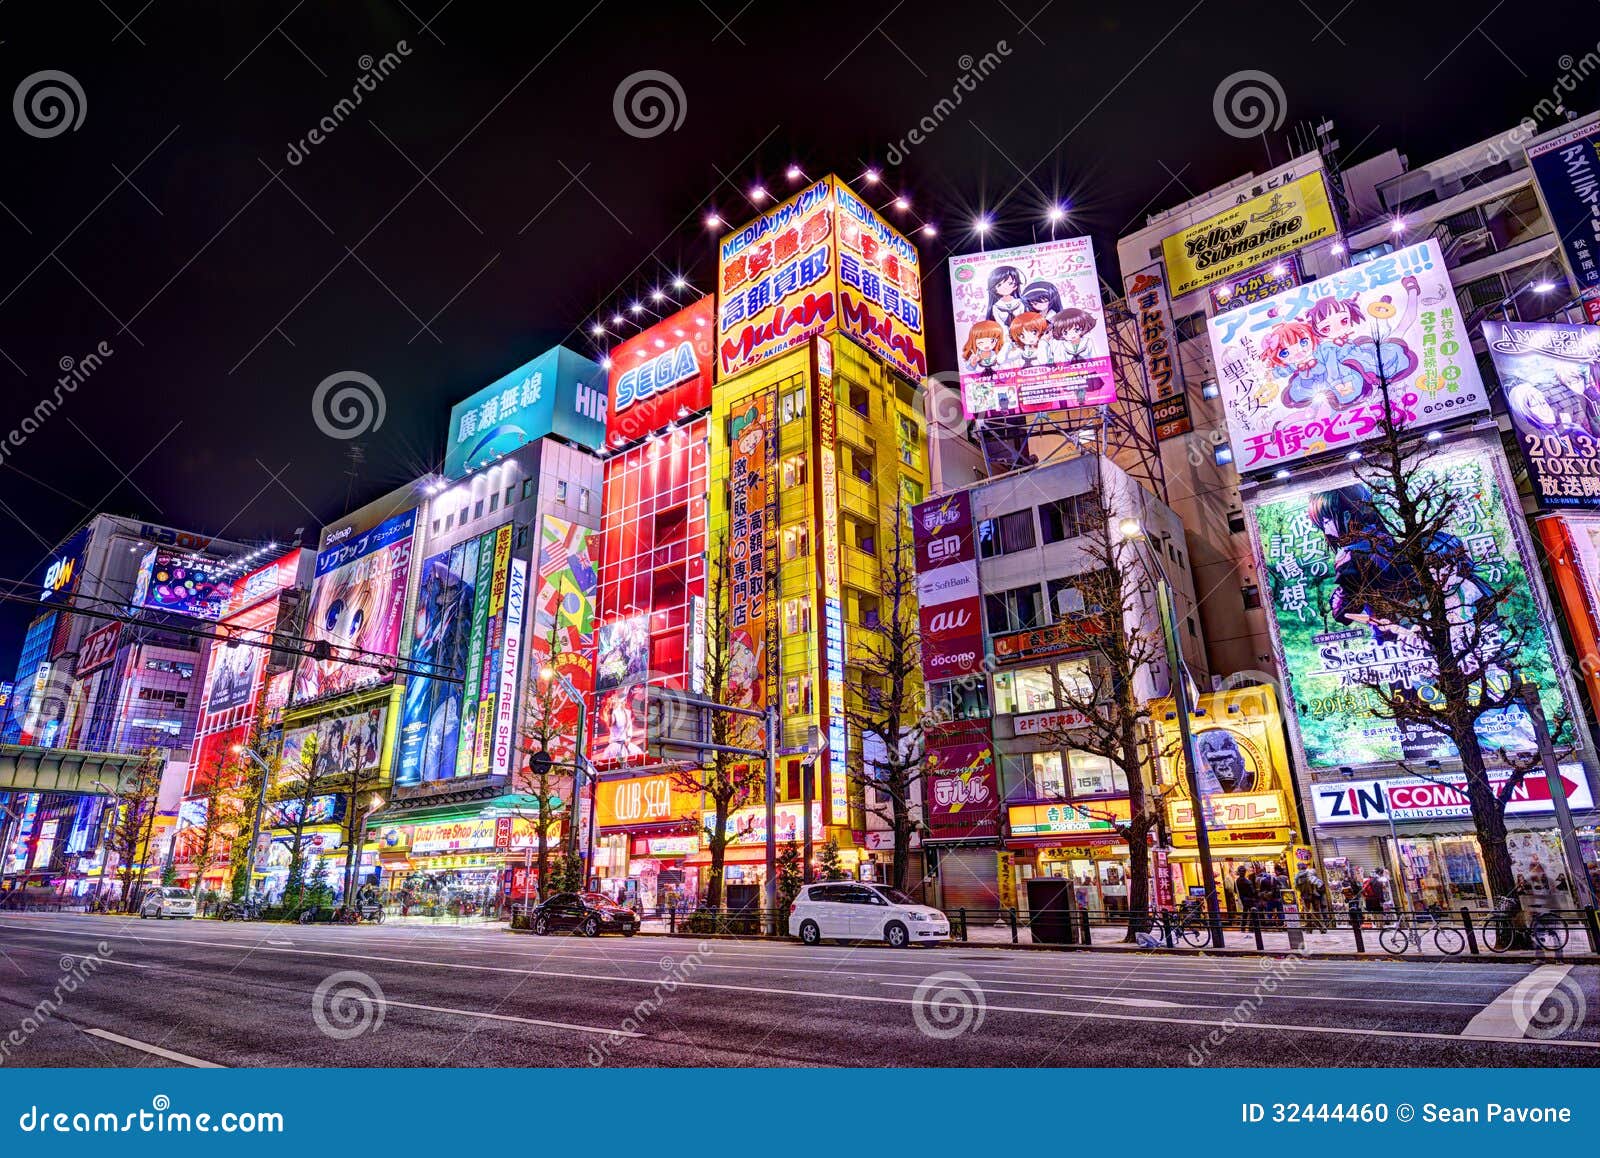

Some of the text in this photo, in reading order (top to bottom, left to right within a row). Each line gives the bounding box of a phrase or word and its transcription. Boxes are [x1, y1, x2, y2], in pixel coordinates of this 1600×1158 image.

[1186, 211, 1240, 239] HOBBY BASE
[1186, 221, 1248, 256] Yellow
[1196, 216, 1302, 270] Submarine
[722, 208, 831, 292] 激安販売
[1573, 239, 1600, 281] 秋葉原店
[720, 246, 830, 334] 高額買取
[839, 251, 921, 336] 高額買取
[1215, 244, 1434, 343] アニメ化決定!!!
[721, 292, 835, 374] Mulan
[763, 342, 788, 358] AKIBA
[841, 292, 928, 377] Mulan
[878, 347, 897, 364] AKIBA
[614, 341, 701, 412] SEGA
[1222, 359, 1269, 417] 聖少女
[456, 371, 543, 444] 廣瀬無線
[1162, 424, 1178, 436] 3F
[923, 510, 961, 531] テルル
[321, 535, 369, 571] ソフマップ
[732, 456, 749, 628] 激安販売の専門店
[749, 509, 764, 619] 高額買取と
[935, 575, 971, 591] SoftBank
[1270, 534, 1317, 622] 記憶と想い
[695, 602, 704, 635] GAME
[930, 608, 972, 633] au
[504, 638, 517, 678] DUTY
[931, 652, 976, 667] docomo
[500, 682, 513, 721] FREE
[496, 726, 509, 768] SHOP
[1486, 723, 1511, 733] huke
[615, 778, 671, 820] CLUB SEGA
[934, 777, 990, 806] テルル
[1320, 782, 1385, 819] ZIN
[416, 826, 434, 842] Duty
[434, 823, 452, 840] Free
[451, 822, 472, 839] Shop
[1050, 822, 1091, 831] YOSHINOYA
